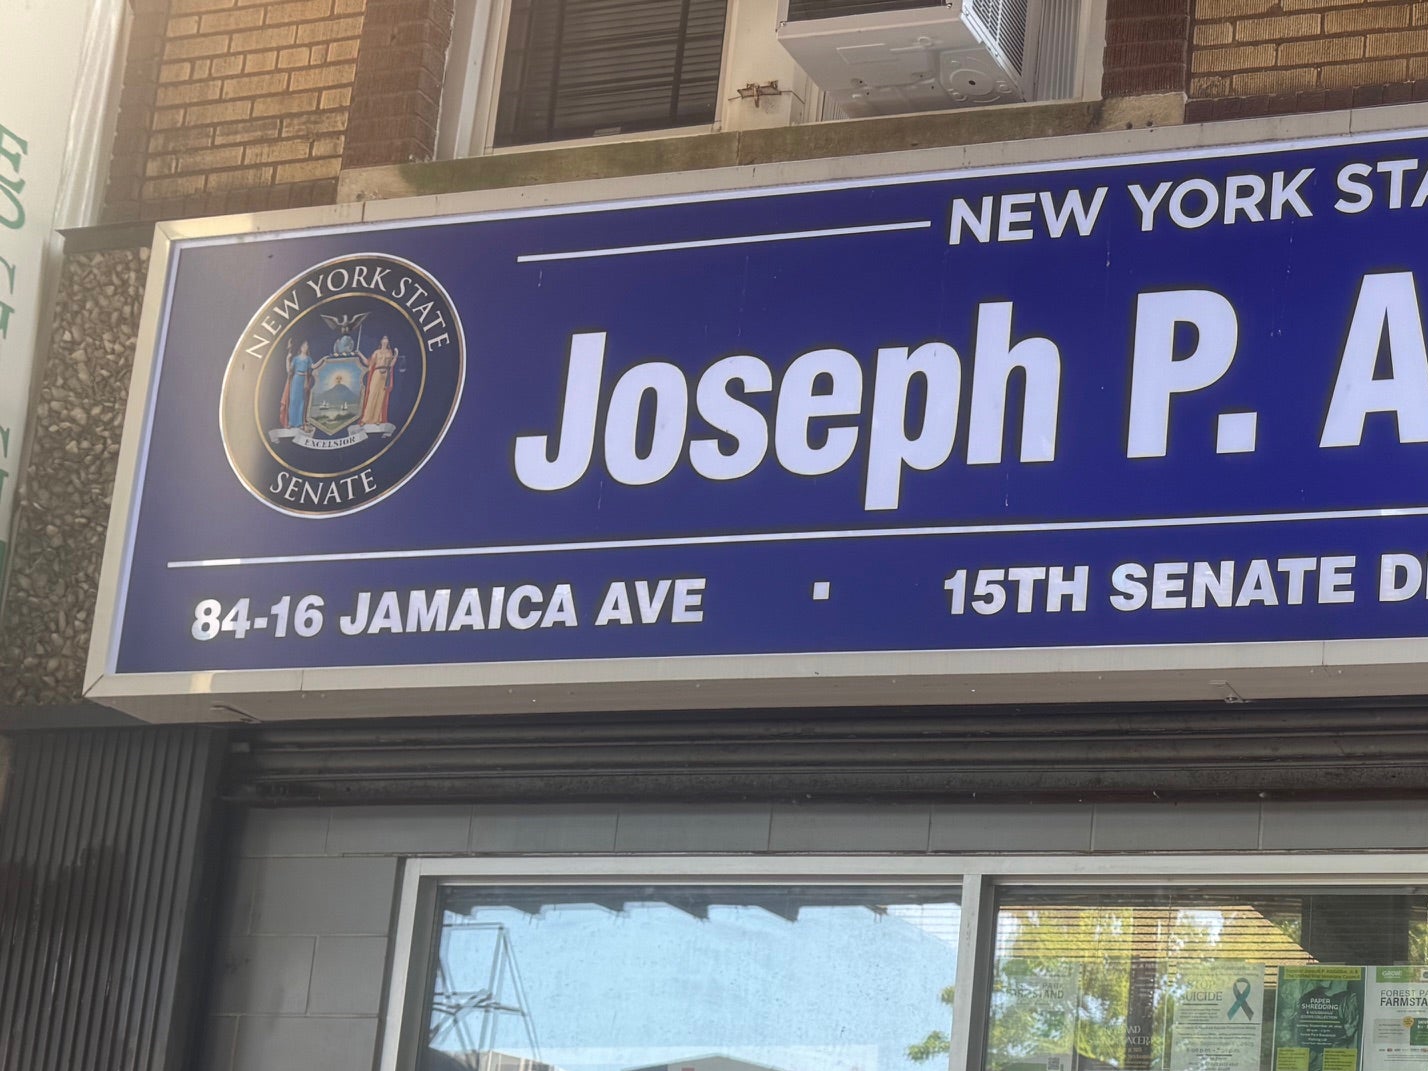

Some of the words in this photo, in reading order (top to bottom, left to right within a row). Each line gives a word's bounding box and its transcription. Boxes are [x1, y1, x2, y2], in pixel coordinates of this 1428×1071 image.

[948, 186, 1108, 246] NEW
[1129, 168, 1313, 233] YORK
[245, 290, 300, 360] NEW
[307, 266, 393, 299] YORK
[392, 277, 450, 352] STATE
[514, 301, 1062, 512] Joseph
[1127, 289, 1258, 459] P.
[304, 435, 356, 449] EXCELSIOR
[270, 468, 377, 506] SENATE
[191, 595, 325, 642] 84-16
[340, 583, 578, 637] JAMAICA
[595, 578, 707, 627] AVE
[943, 565, 1088, 617] 15TH
[1110, 556, 1357, 612] SENATE
[1380, 989, 1416, 997] FOREST
